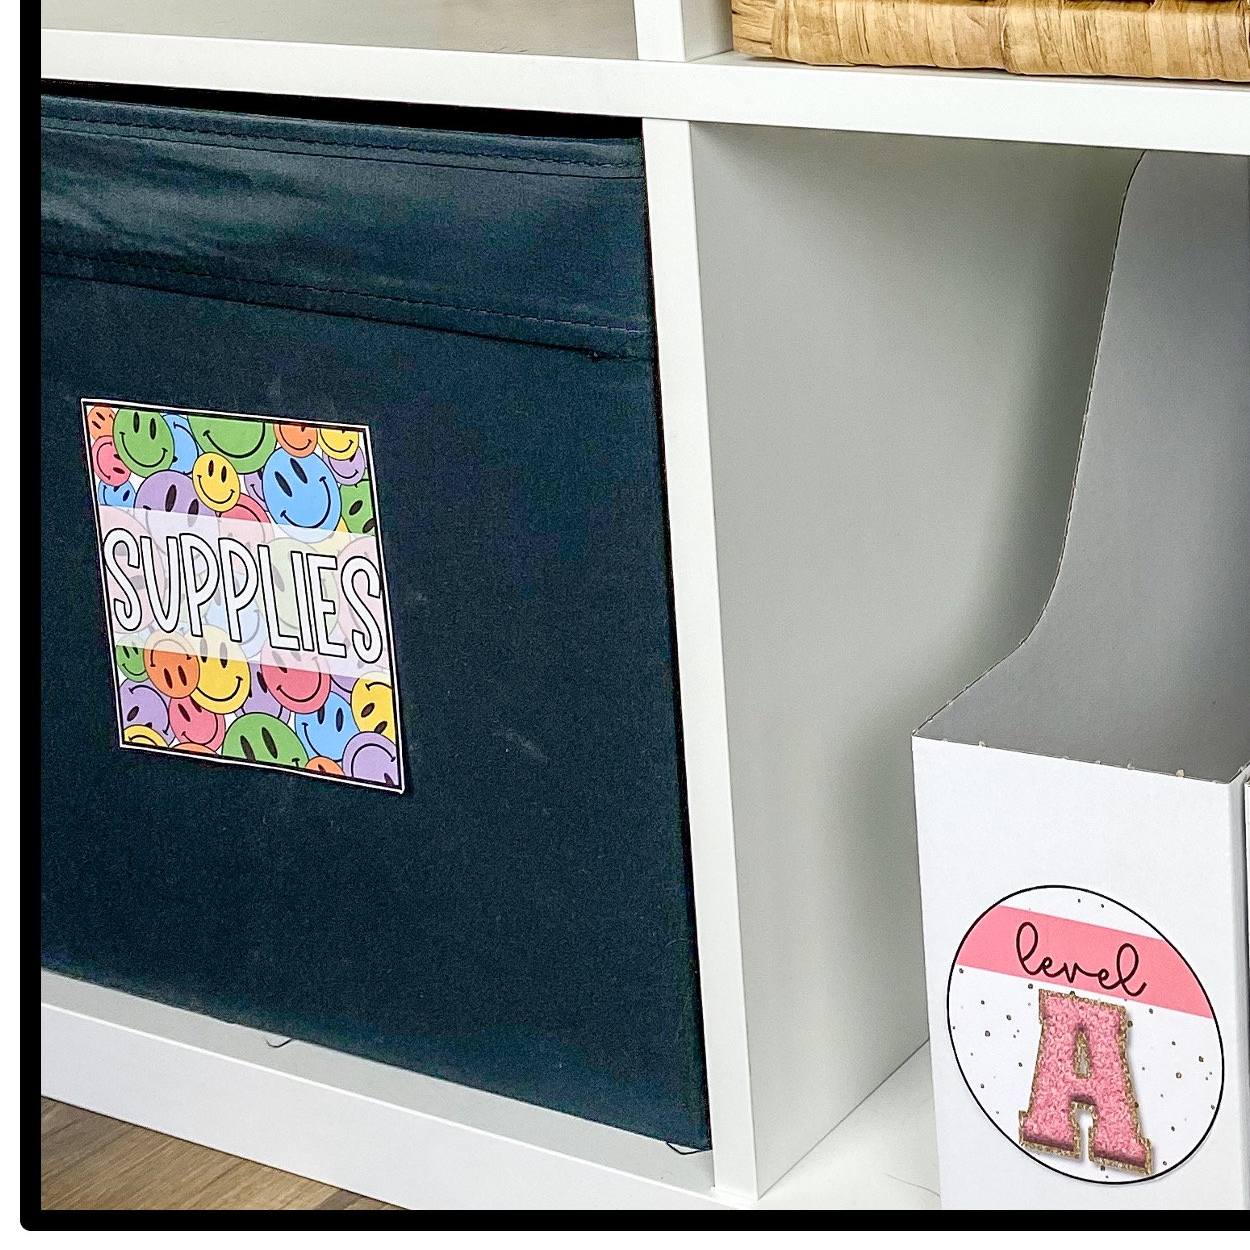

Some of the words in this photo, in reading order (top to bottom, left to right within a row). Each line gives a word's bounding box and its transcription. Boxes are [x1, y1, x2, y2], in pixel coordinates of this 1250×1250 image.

[103, 527, 384, 664] SUPPLIES
[1015, 921, 1148, 997] level
[1018, 988, 1155, 1177] A
